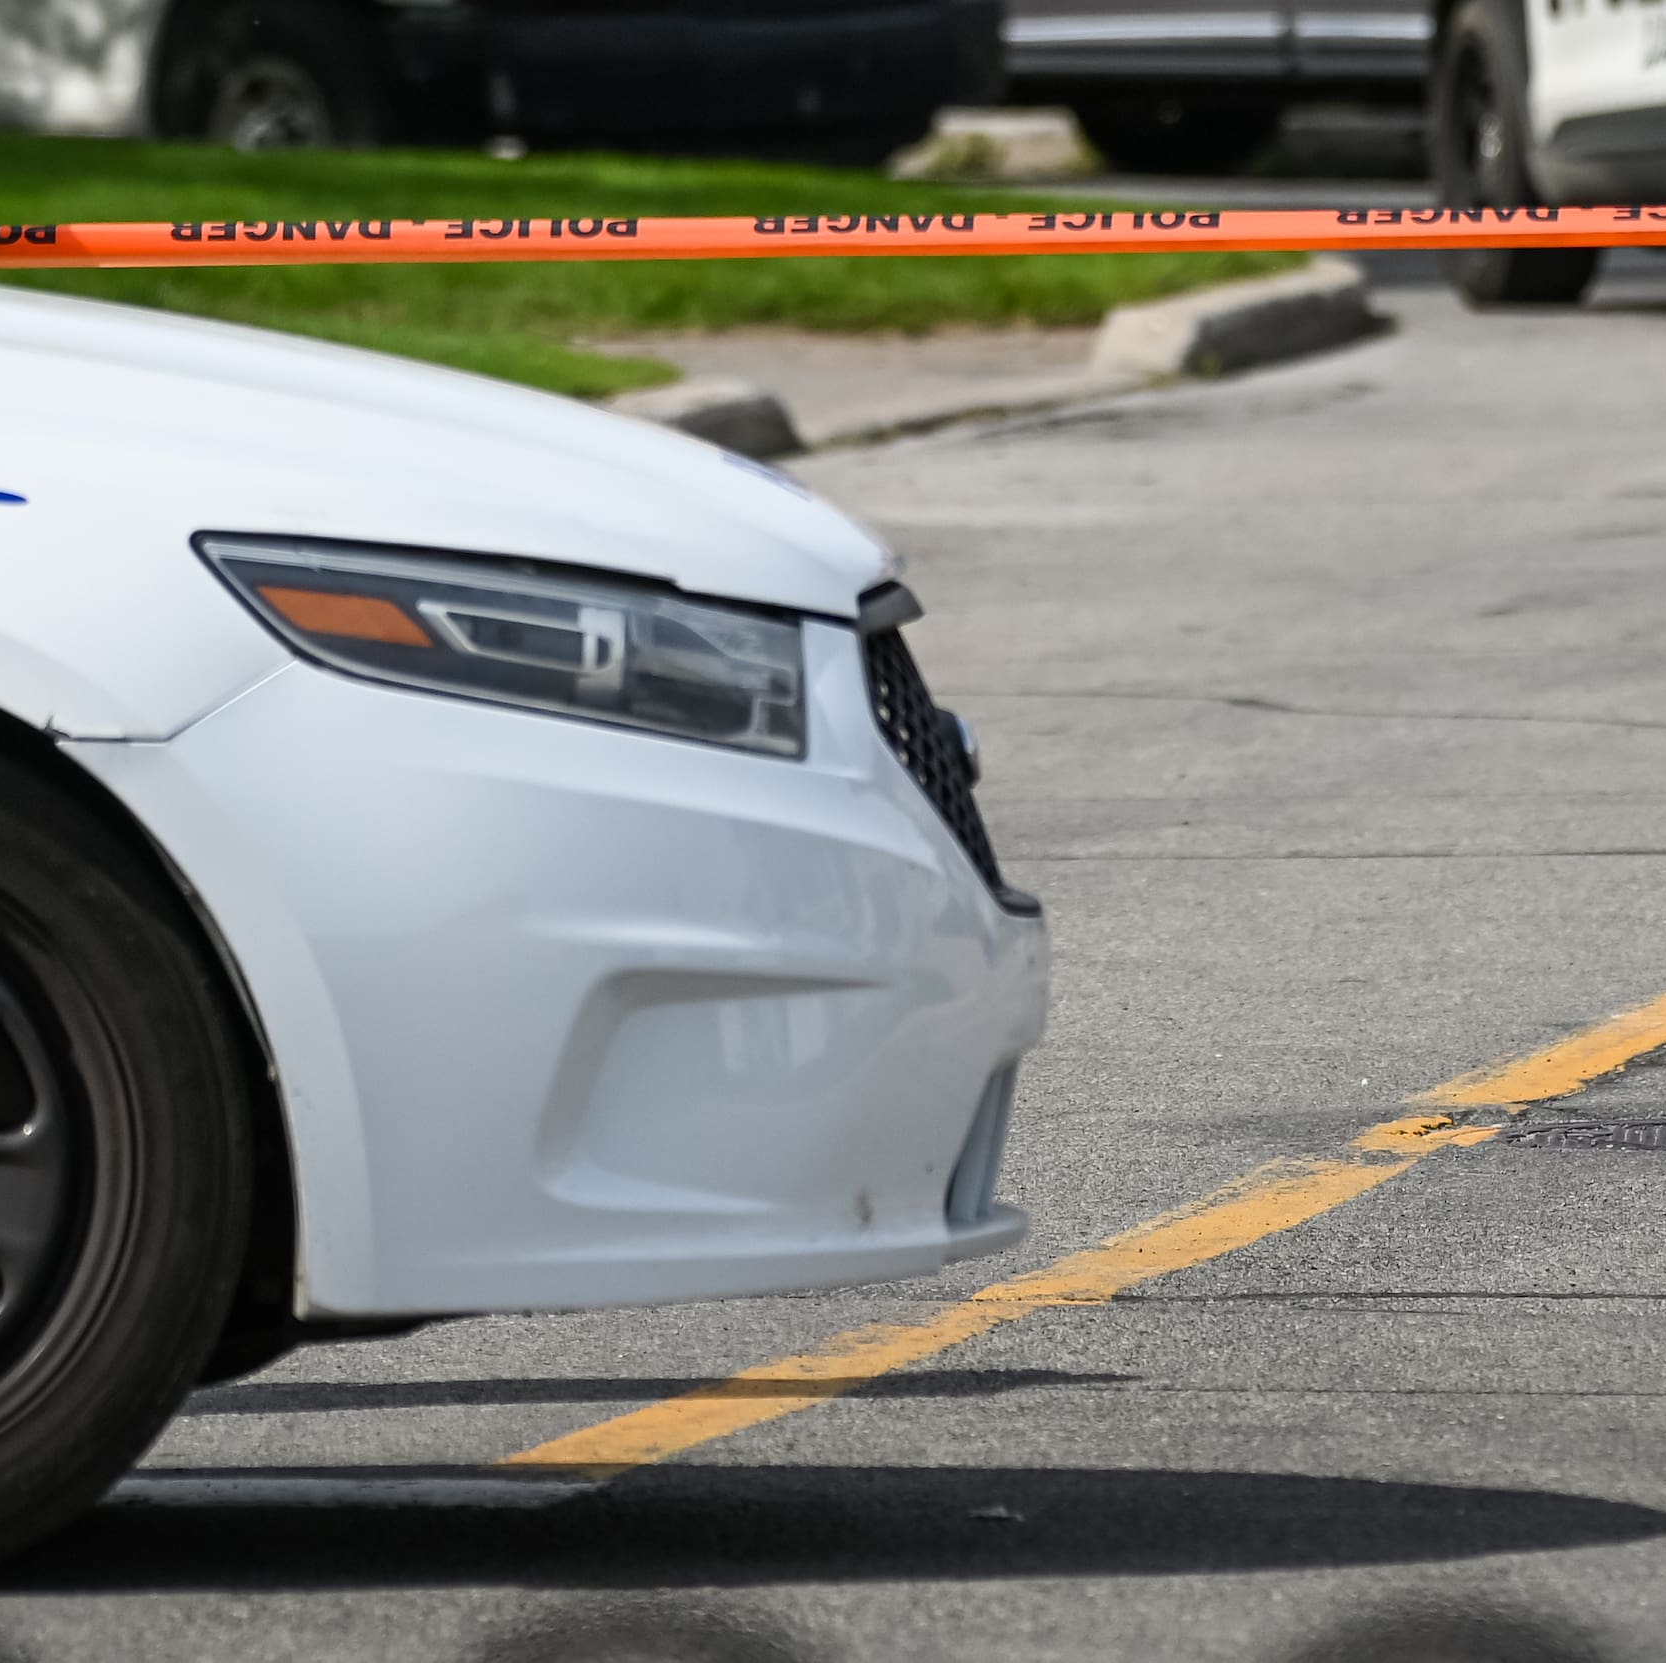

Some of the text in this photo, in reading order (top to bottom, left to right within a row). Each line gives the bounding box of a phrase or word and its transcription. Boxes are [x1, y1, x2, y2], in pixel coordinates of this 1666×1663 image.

[171, 220, 391, 241] DANGER
[444, 217, 637, 239] POLICE
[754, 214, 974, 235] DANGER
[1028, 212, 1220, 231] POLICE
